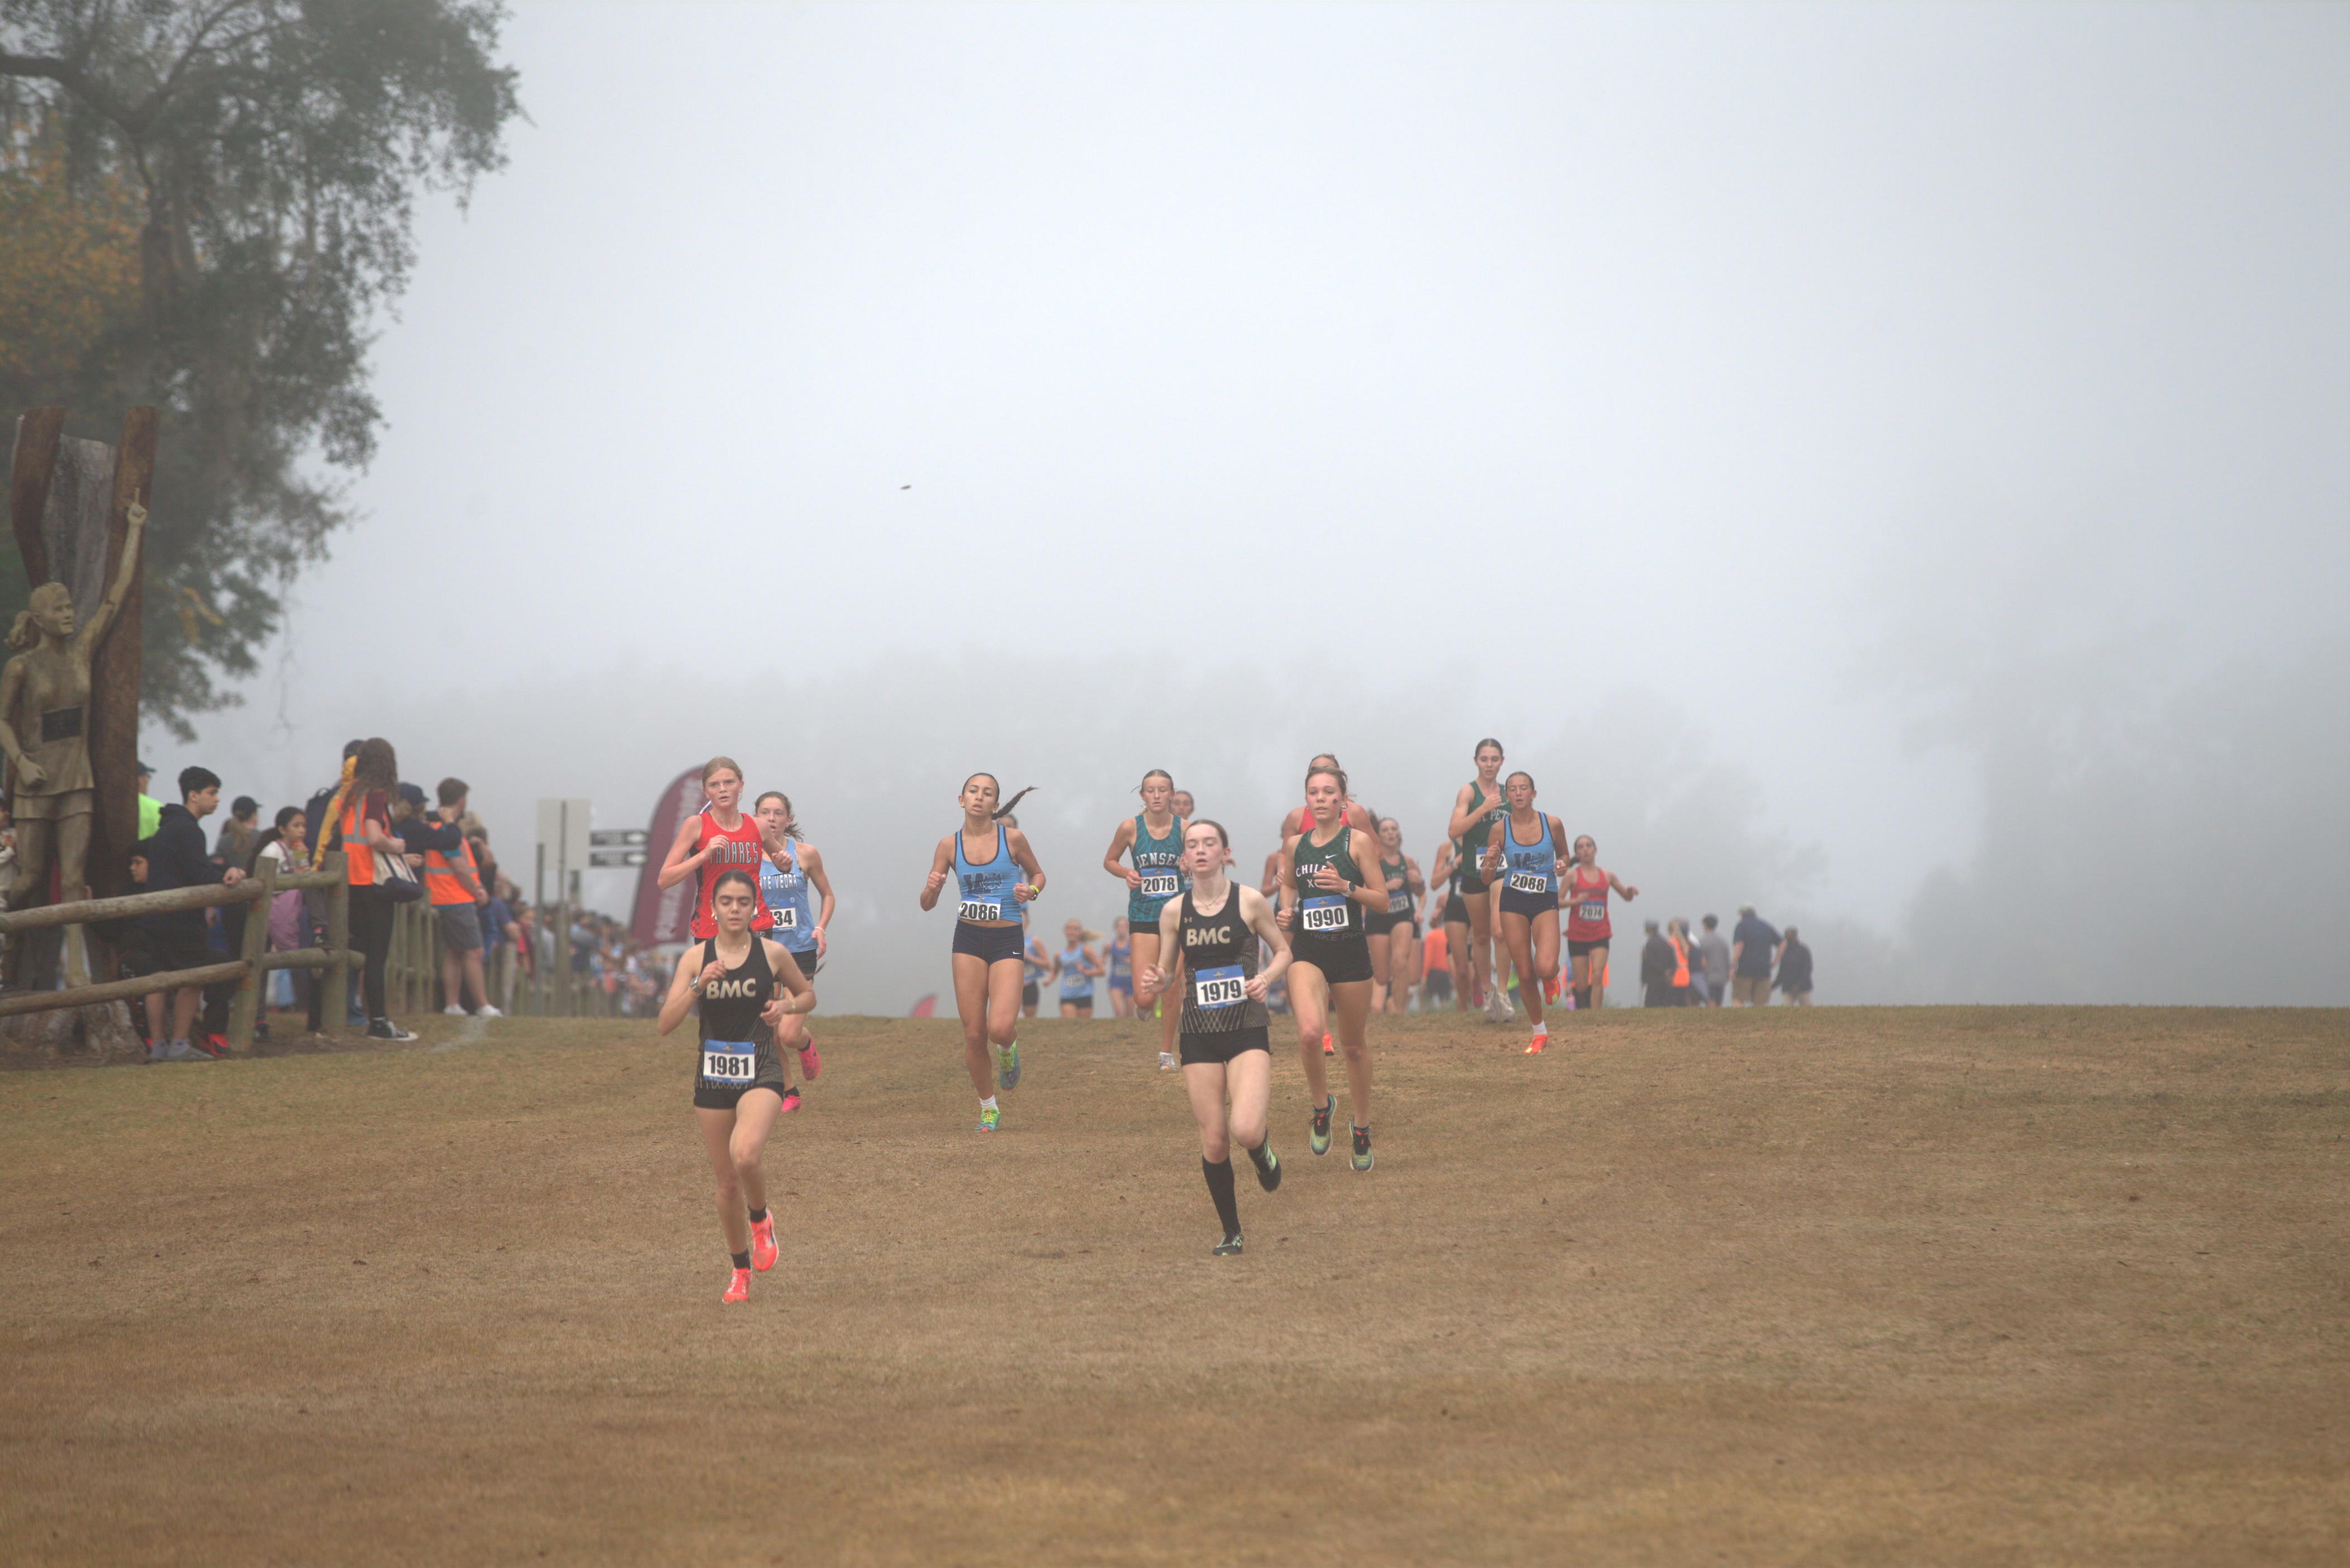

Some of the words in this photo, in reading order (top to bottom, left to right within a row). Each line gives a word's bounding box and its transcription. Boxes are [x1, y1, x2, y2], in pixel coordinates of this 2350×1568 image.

[1490, 809, 1510, 820] PET
[1296, 864, 1331, 877] CHIL
[1480, 856, 1504, 868] 22
[775, 873, 797, 890] VEDRA
[1143, 877, 1175, 892] 2078
[1511, 874, 1545, 891] 2088
[771, 910, 793, 926] 34
[960, 902, 998, 920] 2086
[1305, 907, 1345, 928] 1990
[1186, 926, 1231, 947] BMC
[706, 977, 756, 999] BMC
[1200, 980, 1242, 1002] 1979
[708, 1055, 748, 1076] 1981
